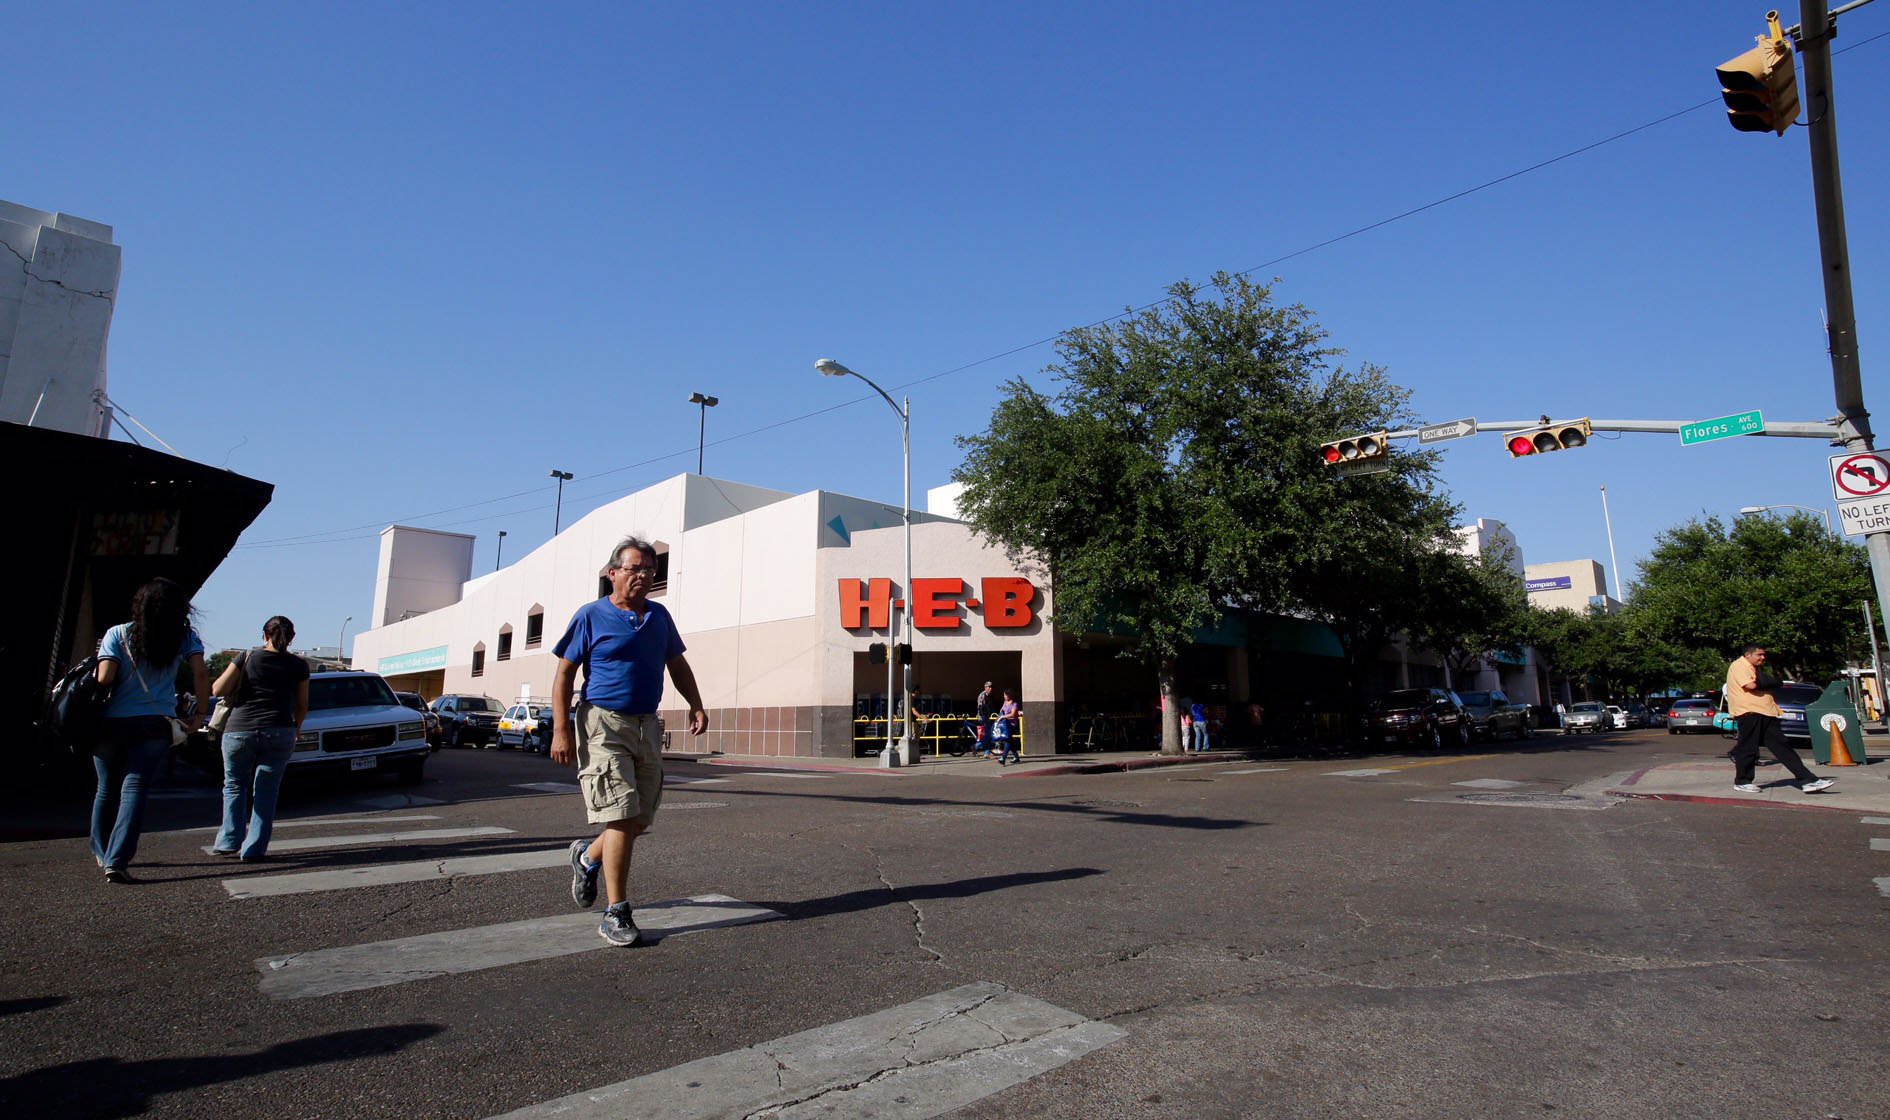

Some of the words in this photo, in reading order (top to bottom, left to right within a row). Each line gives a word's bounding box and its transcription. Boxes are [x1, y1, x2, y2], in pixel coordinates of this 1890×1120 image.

[1738, 415, 1753, 424] AVE
[1685, 424, 1728, 439] Flores
[1741, 422, 1758, 431] 600
[1424, 429, 1440, 439] ONE
[1442, 426, 1458, 435] WAY
[1842, 506, 1860, 520] NO
[1864, 503, 1890, 517] LEF
[1525, 581, 1557, 589] Compass
